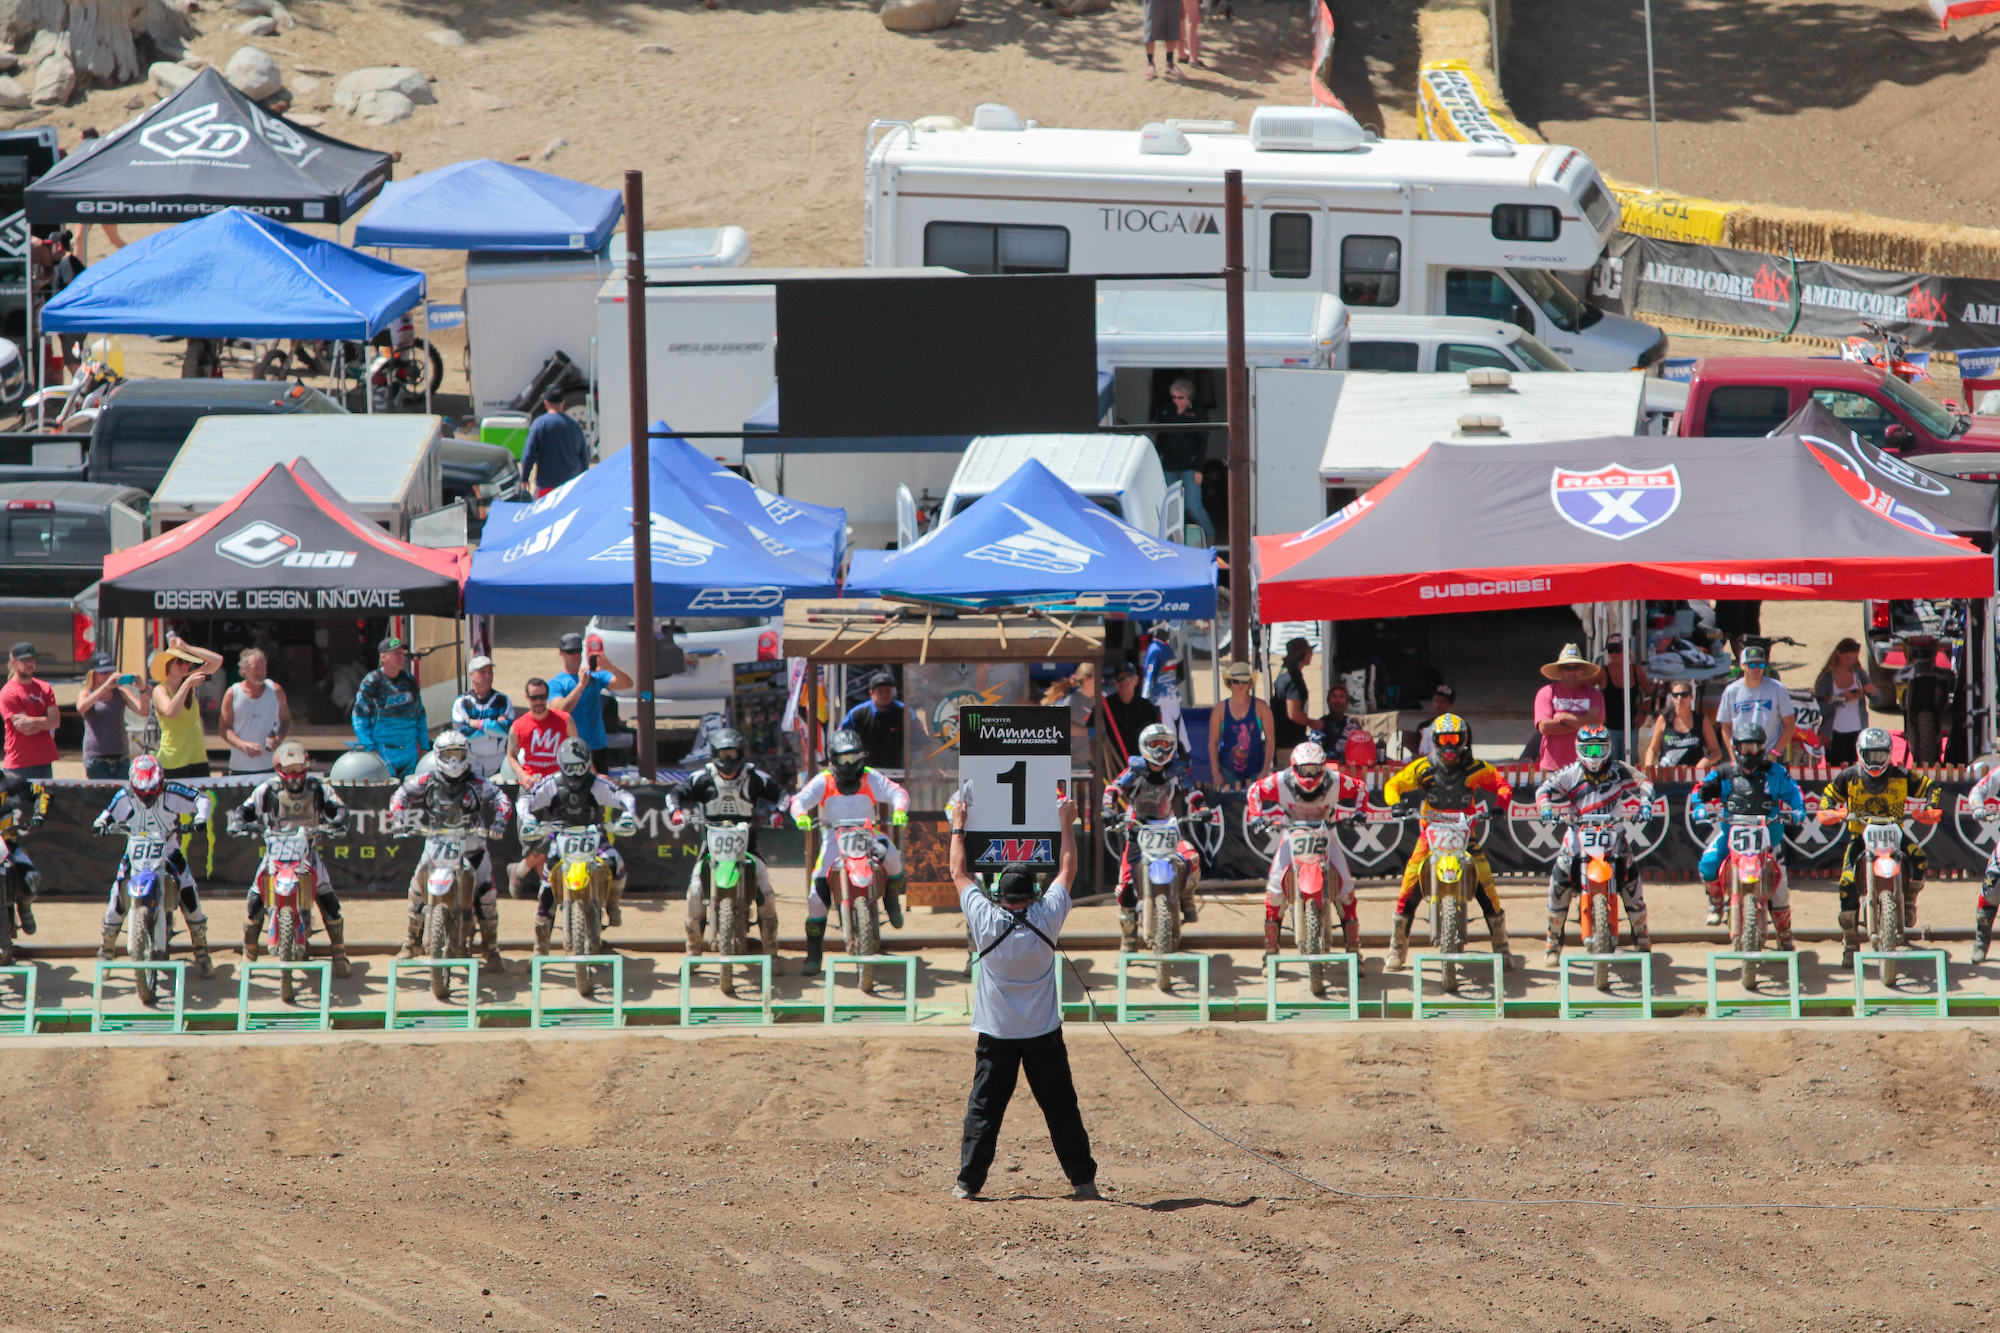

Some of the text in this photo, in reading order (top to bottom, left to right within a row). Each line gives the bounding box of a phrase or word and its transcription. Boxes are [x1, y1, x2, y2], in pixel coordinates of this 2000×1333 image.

[1098, 208, 1188, 233] TIOGA
[1642, 262, 1755, 297] AMERICORE
[1800, 284, 1909, 317] AMERICORE
[1562, 474, 1669, 488] RACER
[1586, 490, 1651, 525] X
[282, 550, 359, 568] odi
[1419, 578, 1551, 600] SUBSCRIBE!
[1700, 572, 1834, 586] SUBSCRIBE!
[154, 588, 405, 610] OBSERVE. DESIGN. INNOVATE.
[979, 724, 1064, 740] Mammoth
[996, 760, 1027, 826] 1
[133, 842, 164, 860] 813
[564, 836, 595, 854] 66
[974, 839, 1056, 862] AMA
[1292, 836, 1329, 856] 312
[1584, 833, 1611, 849] 30
[1733, 829, 1763, 851] 51
